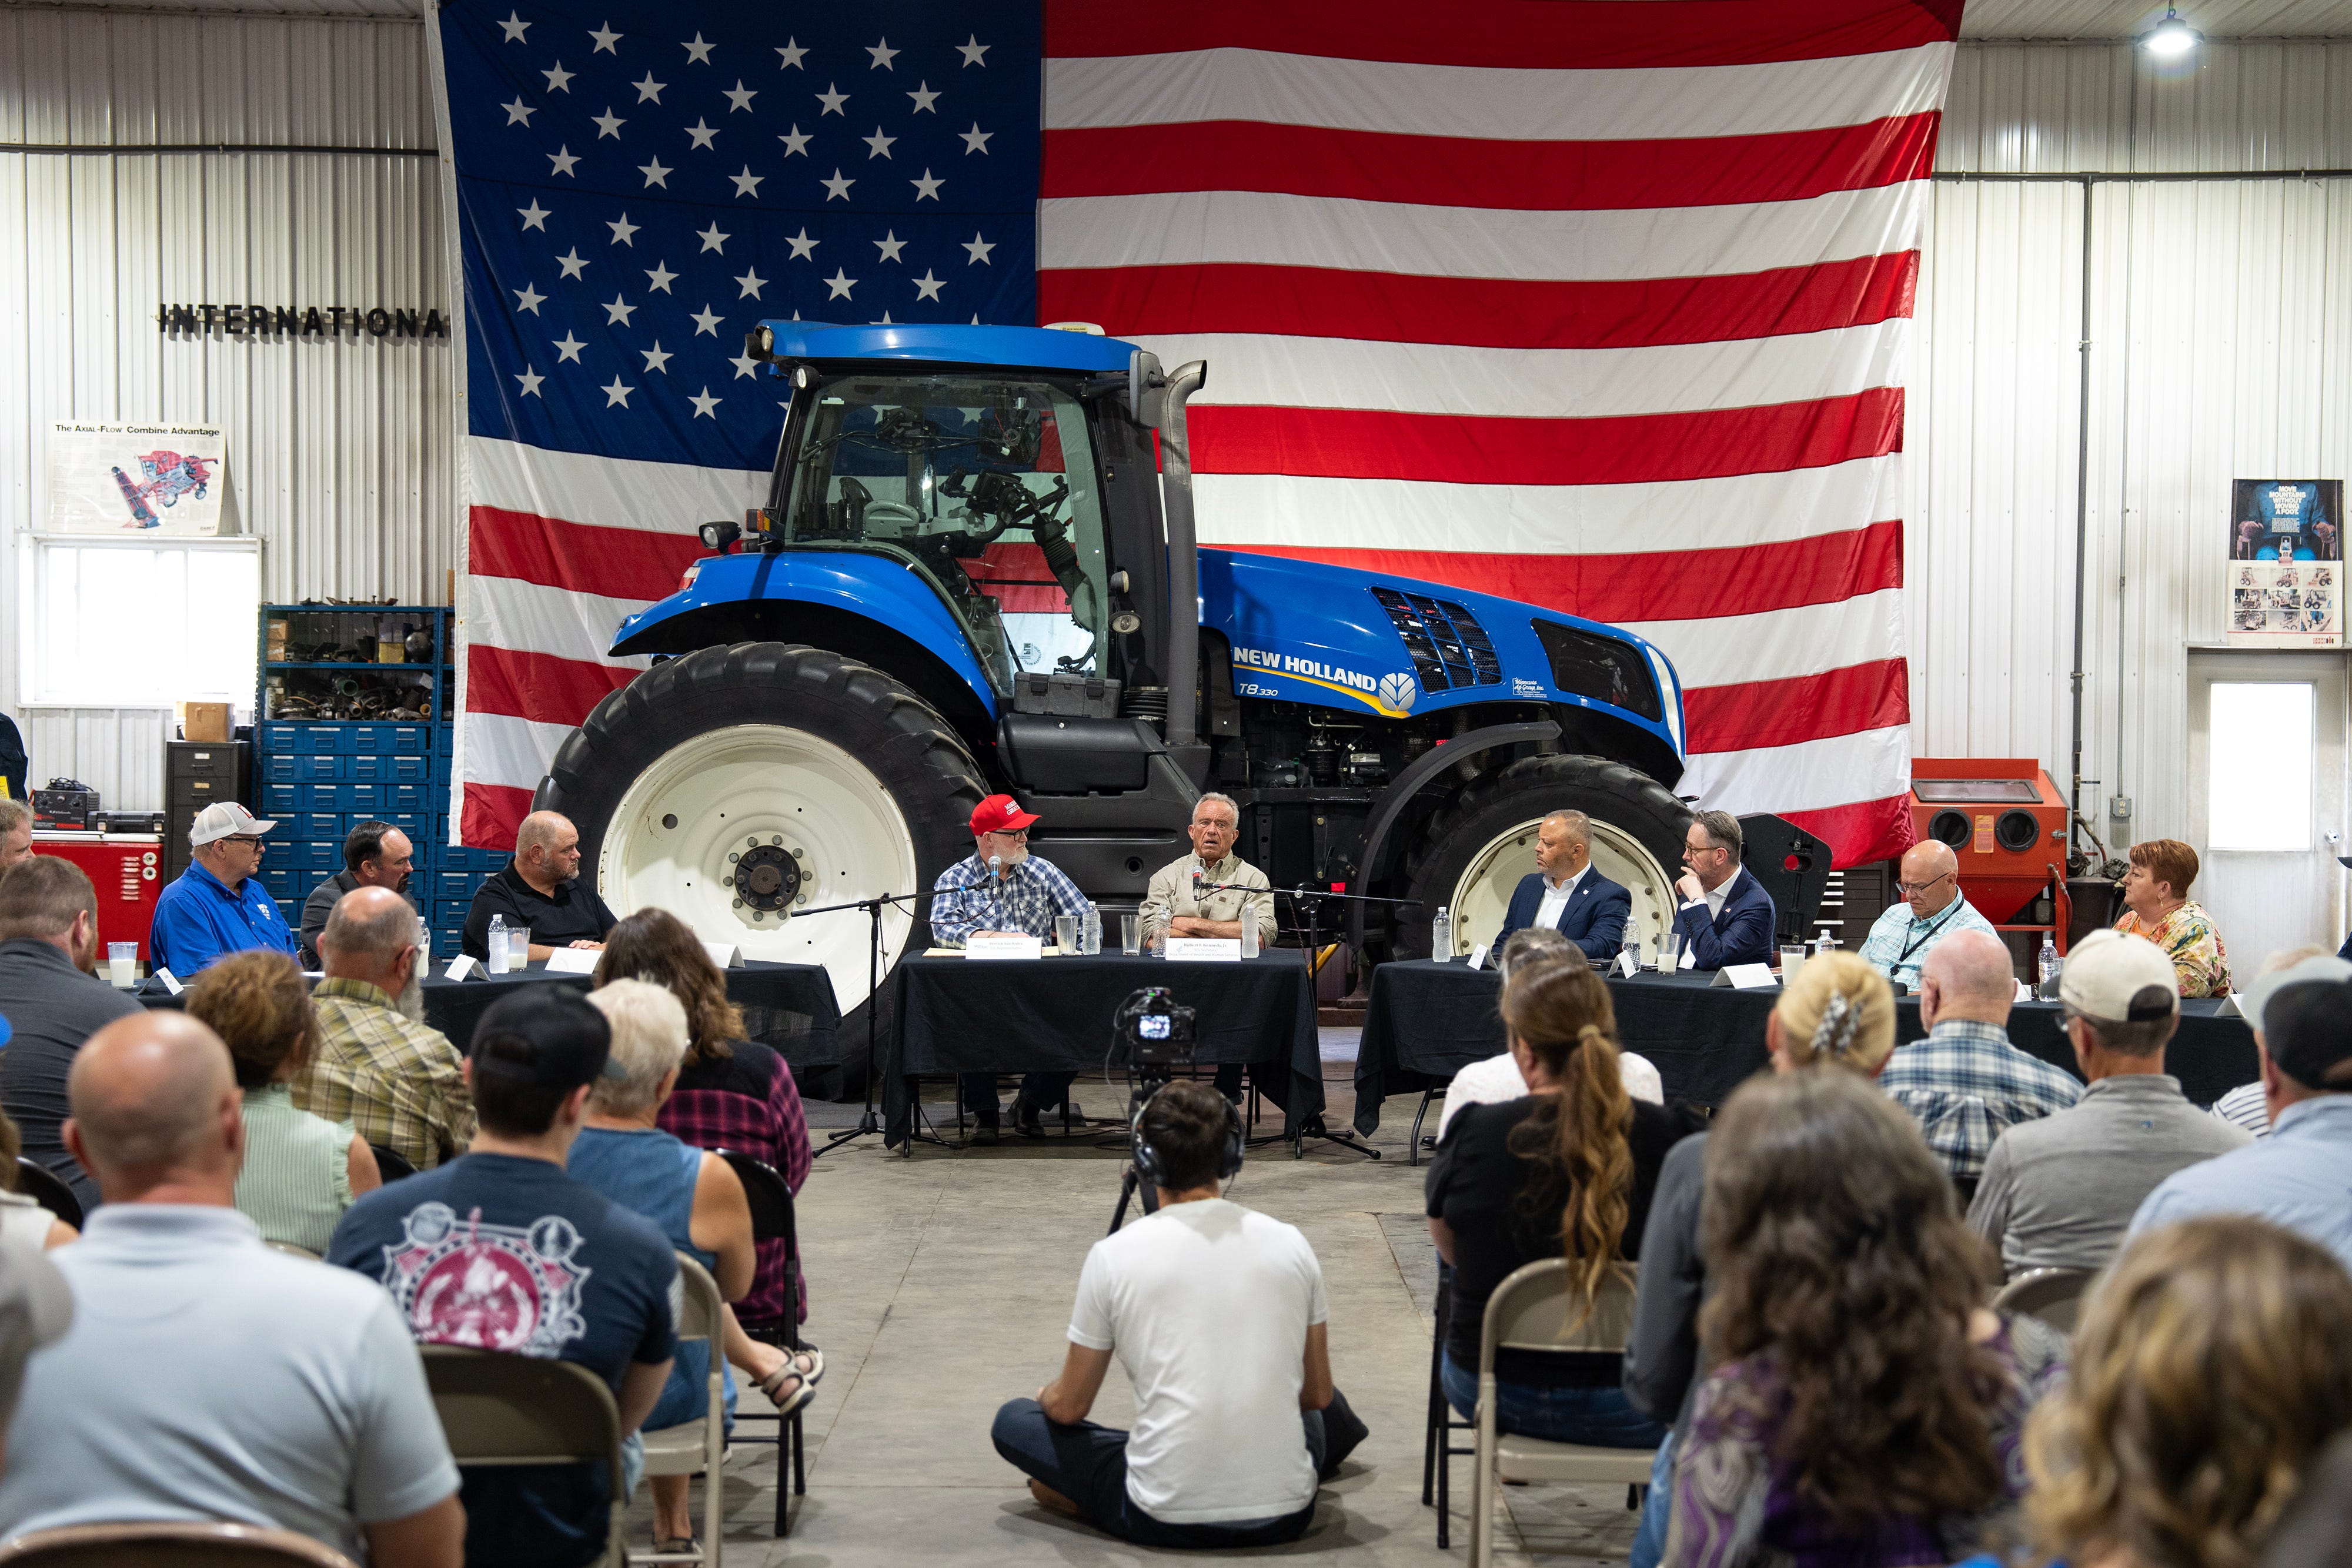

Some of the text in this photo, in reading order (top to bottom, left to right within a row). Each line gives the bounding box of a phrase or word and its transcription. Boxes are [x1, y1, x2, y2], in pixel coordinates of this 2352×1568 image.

[159, 303, 451, 338] INTERNATIONA
[75, 425, 122, 433] AXIAL-FLOW
[127, 426, 168, 434] Combine
[171, 427, 219, 437] Advantage
[1234, 647, 1377, 691] NEW HOLLAND
[1239, 683, 1278, 696] T8.330
